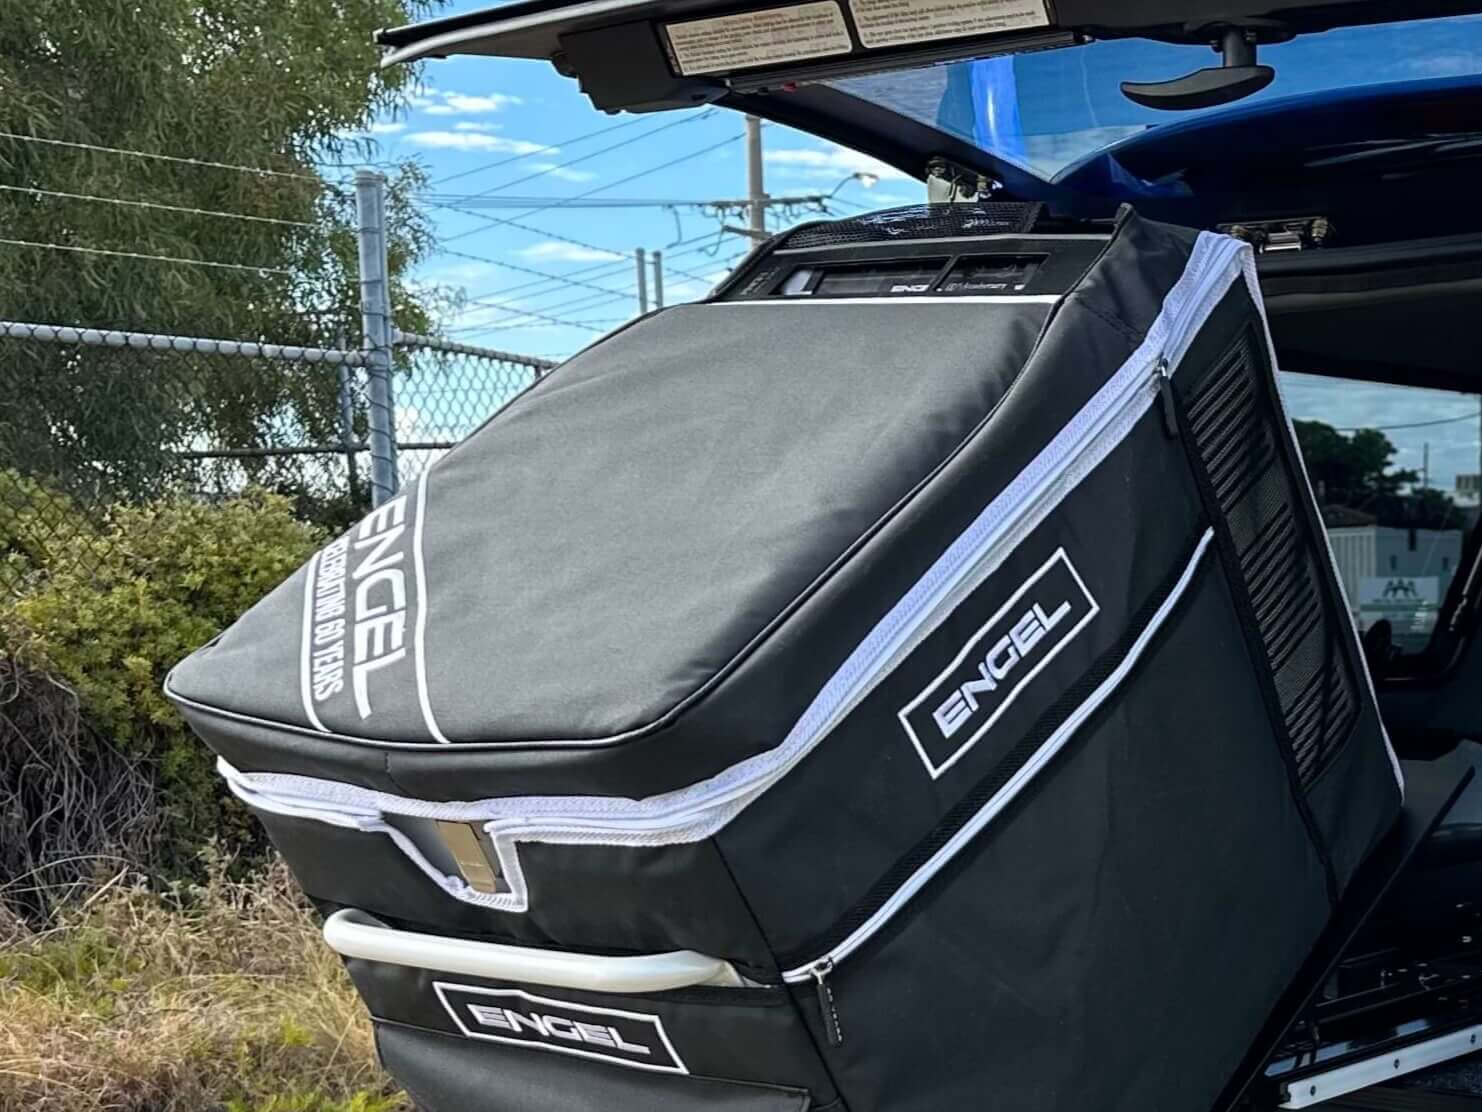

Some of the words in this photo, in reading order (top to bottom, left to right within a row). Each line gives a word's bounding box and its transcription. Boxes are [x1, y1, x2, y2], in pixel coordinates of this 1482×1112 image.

[314, 618, 346, 645] 60
[353, 495, 408, 719] ENGEL
[312, 639, 345, 701] YEARS
[932, 600, 1072, 739] ENGEL
[466, 1003, 651, 1055] ENGEL
